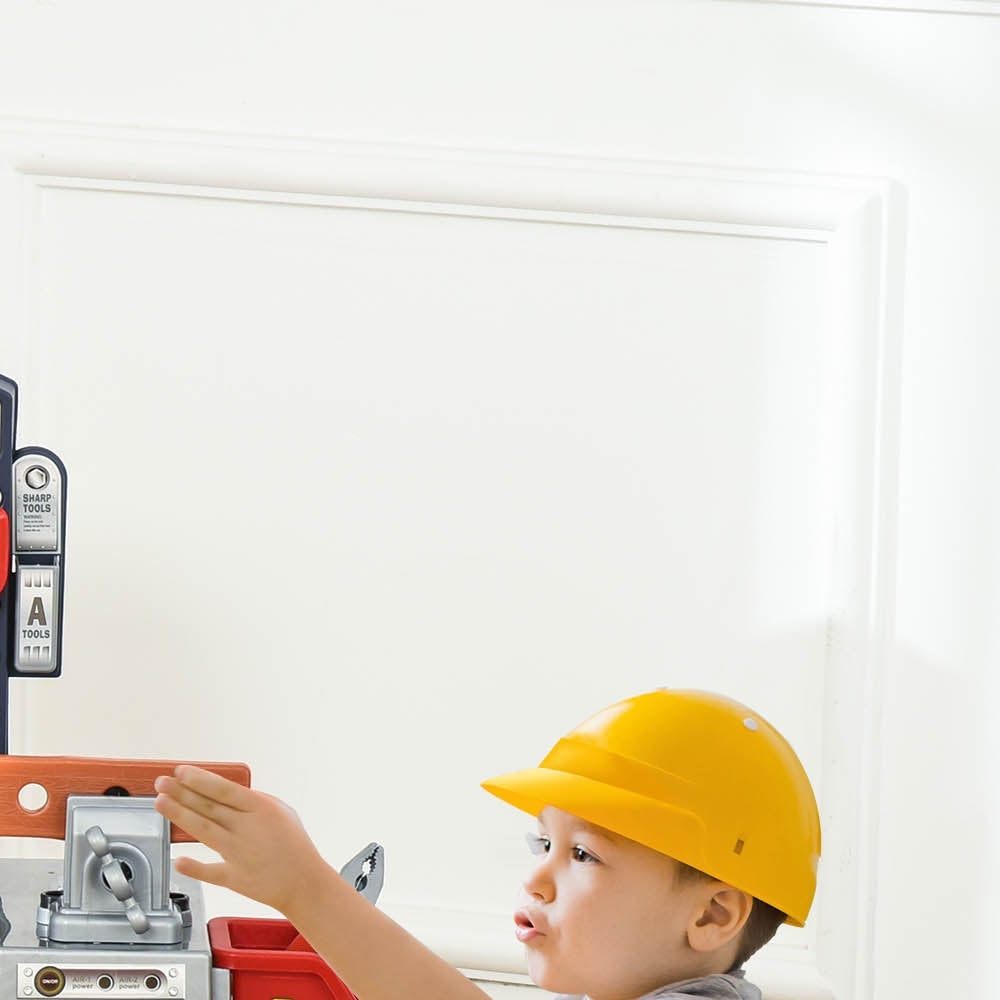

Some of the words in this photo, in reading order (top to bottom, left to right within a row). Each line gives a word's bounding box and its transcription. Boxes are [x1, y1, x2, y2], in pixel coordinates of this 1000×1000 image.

[22, 493, 52, 503] SHARP
[22, 503, 52, 513] TOOLS
[27, 597, 47, 626] A
[22, 629, 50, 639] TOOLS
